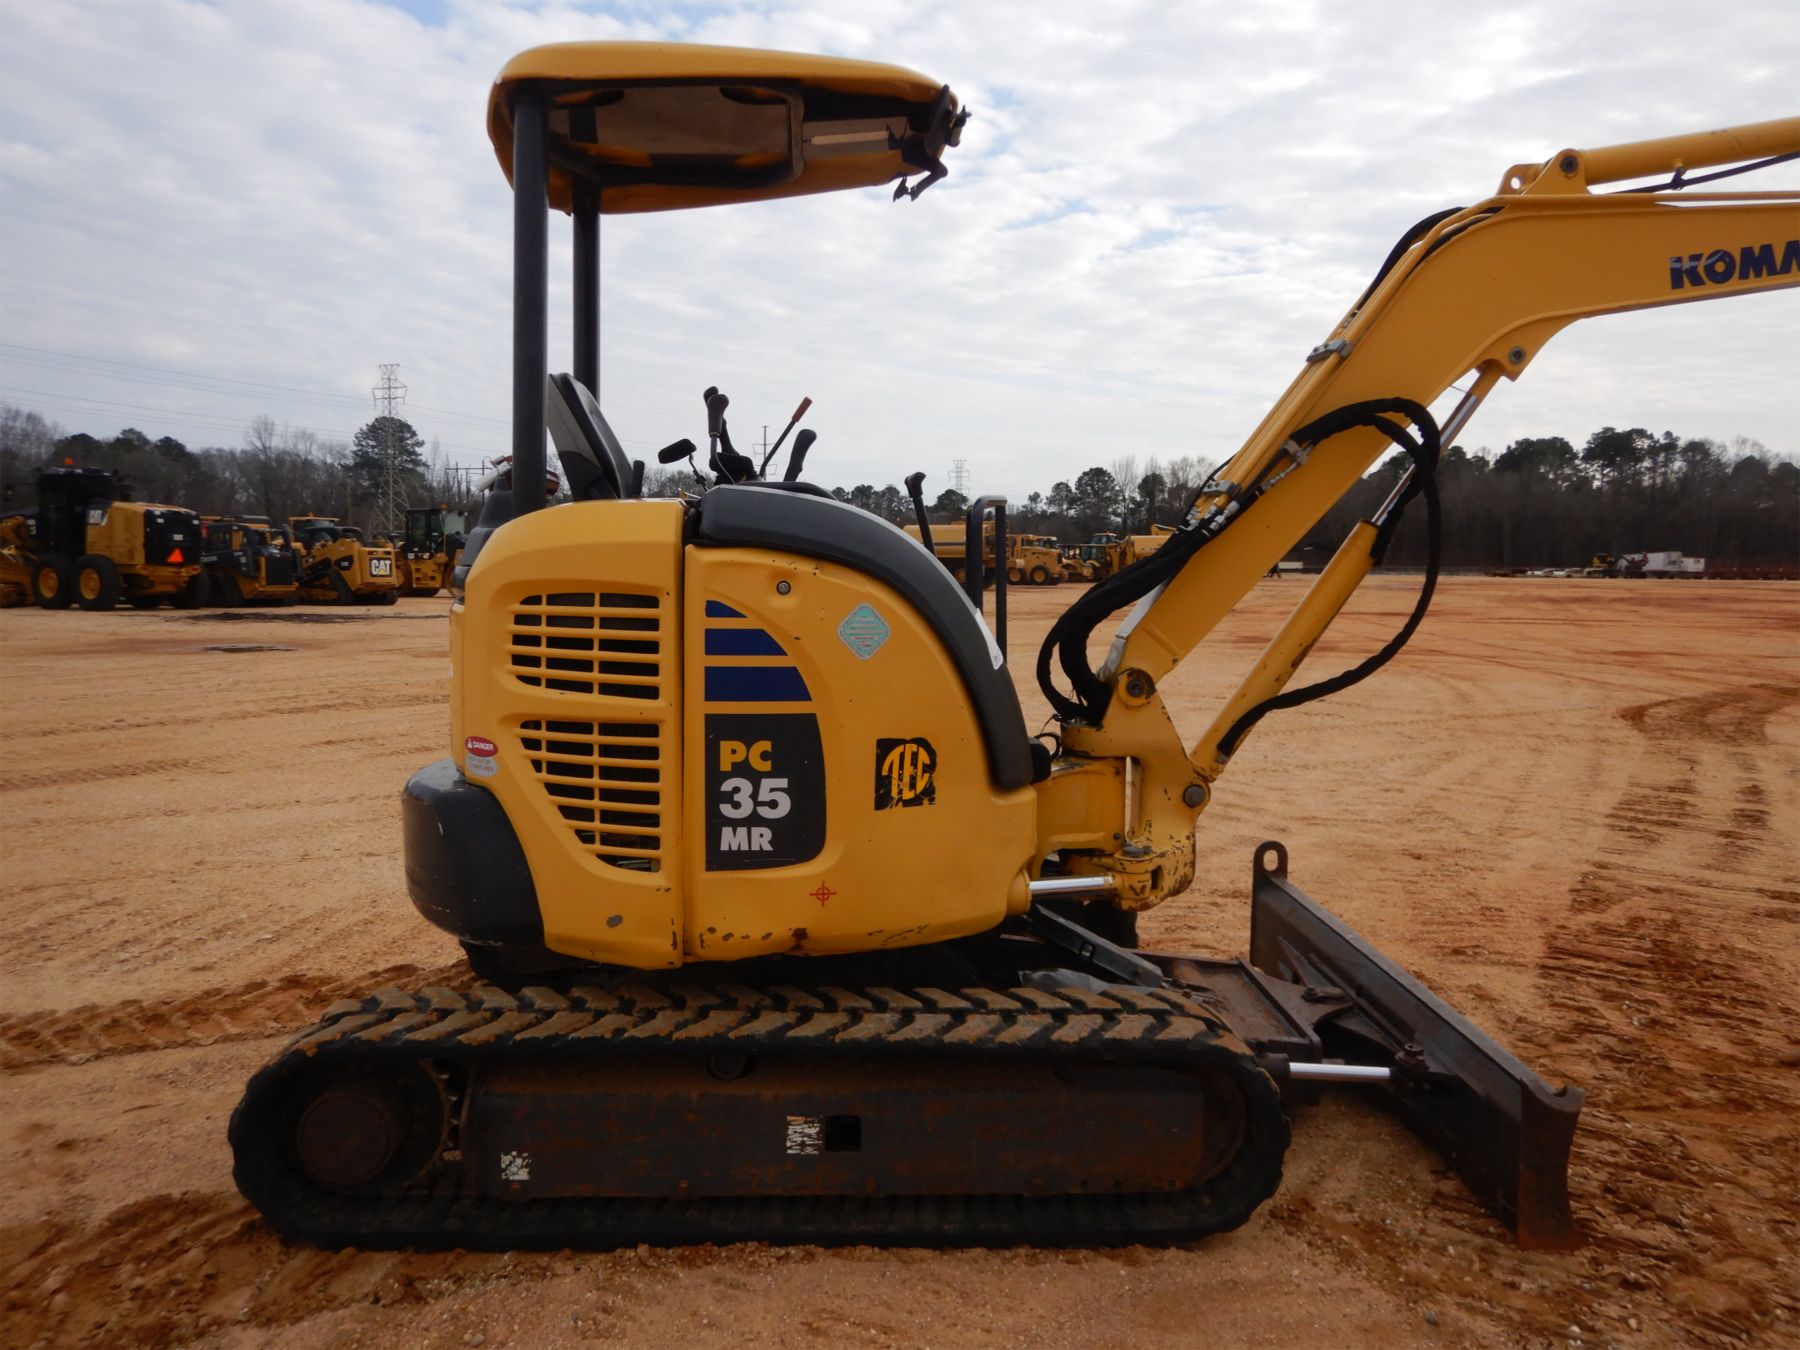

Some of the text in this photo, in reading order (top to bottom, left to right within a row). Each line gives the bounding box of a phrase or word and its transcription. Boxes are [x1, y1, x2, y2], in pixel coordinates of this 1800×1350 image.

[371, 560, 391, 575] CAT
[720, 740, 772, 772] PC
[719, 777, 792, 819] 35
[720, 827, 773, 850] MR
